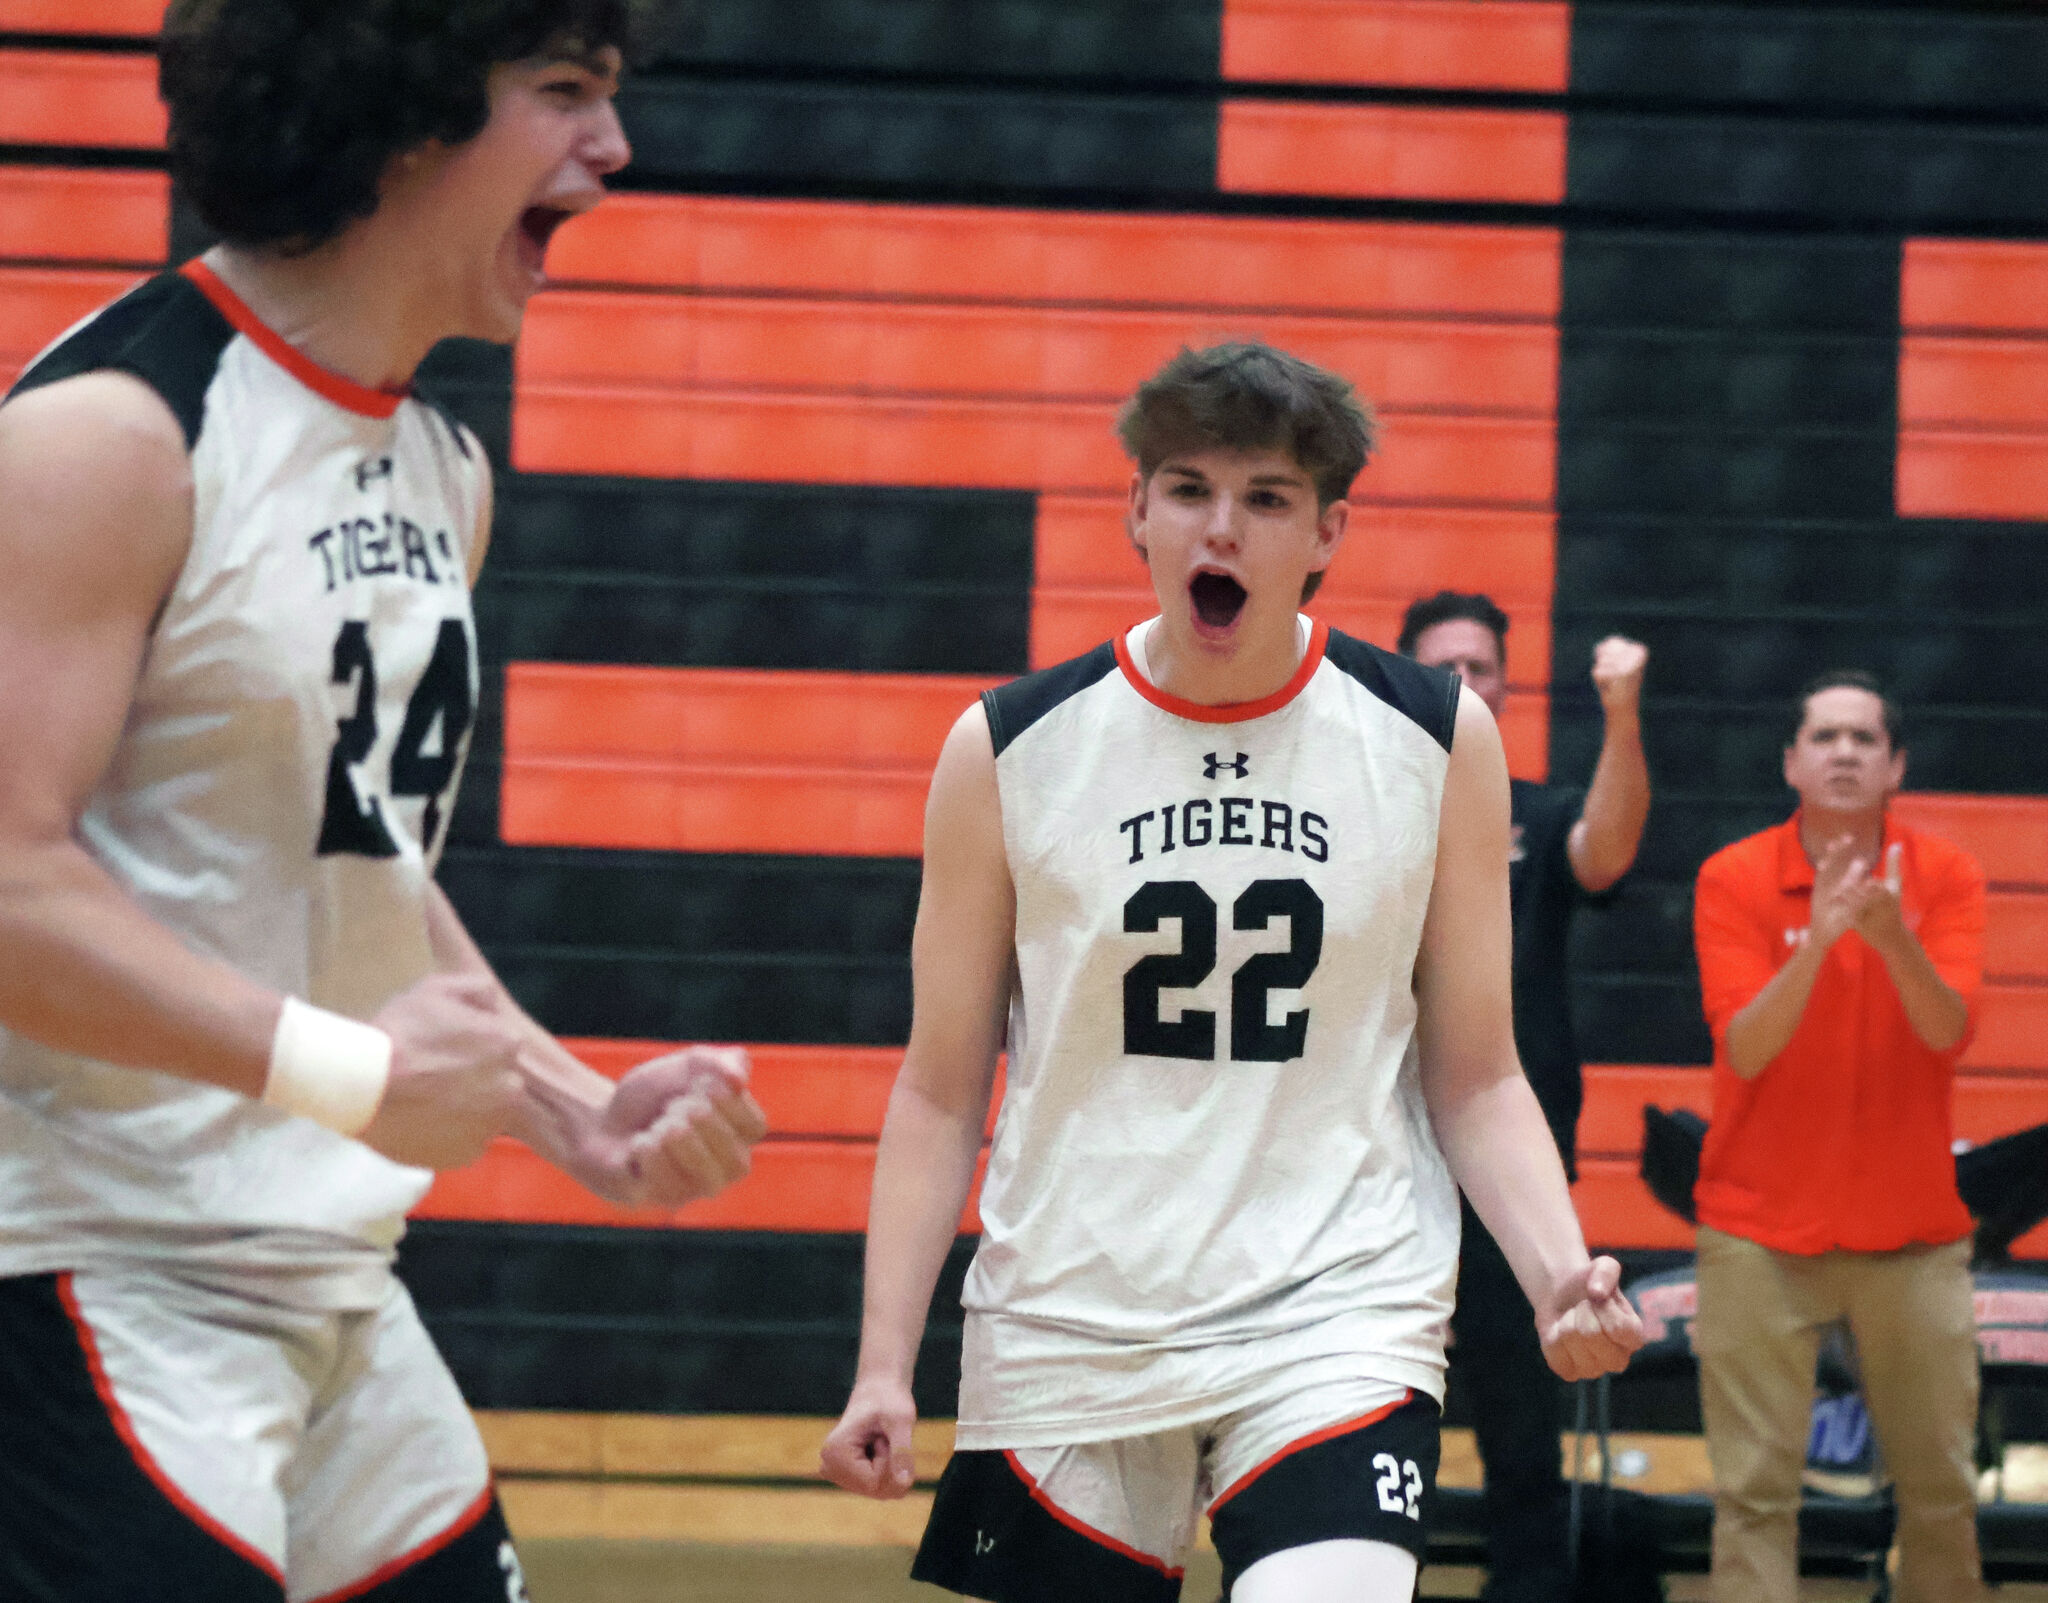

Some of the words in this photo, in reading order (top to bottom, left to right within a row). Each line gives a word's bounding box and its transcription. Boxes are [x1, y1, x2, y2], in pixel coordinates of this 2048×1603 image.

[316, 617, 470, 858] 24
[1120, 797, 1328, 864] TIGERS
[1123, 878, 1324, 1062] 22
[1372, 1453, 1423, 1521] 22
